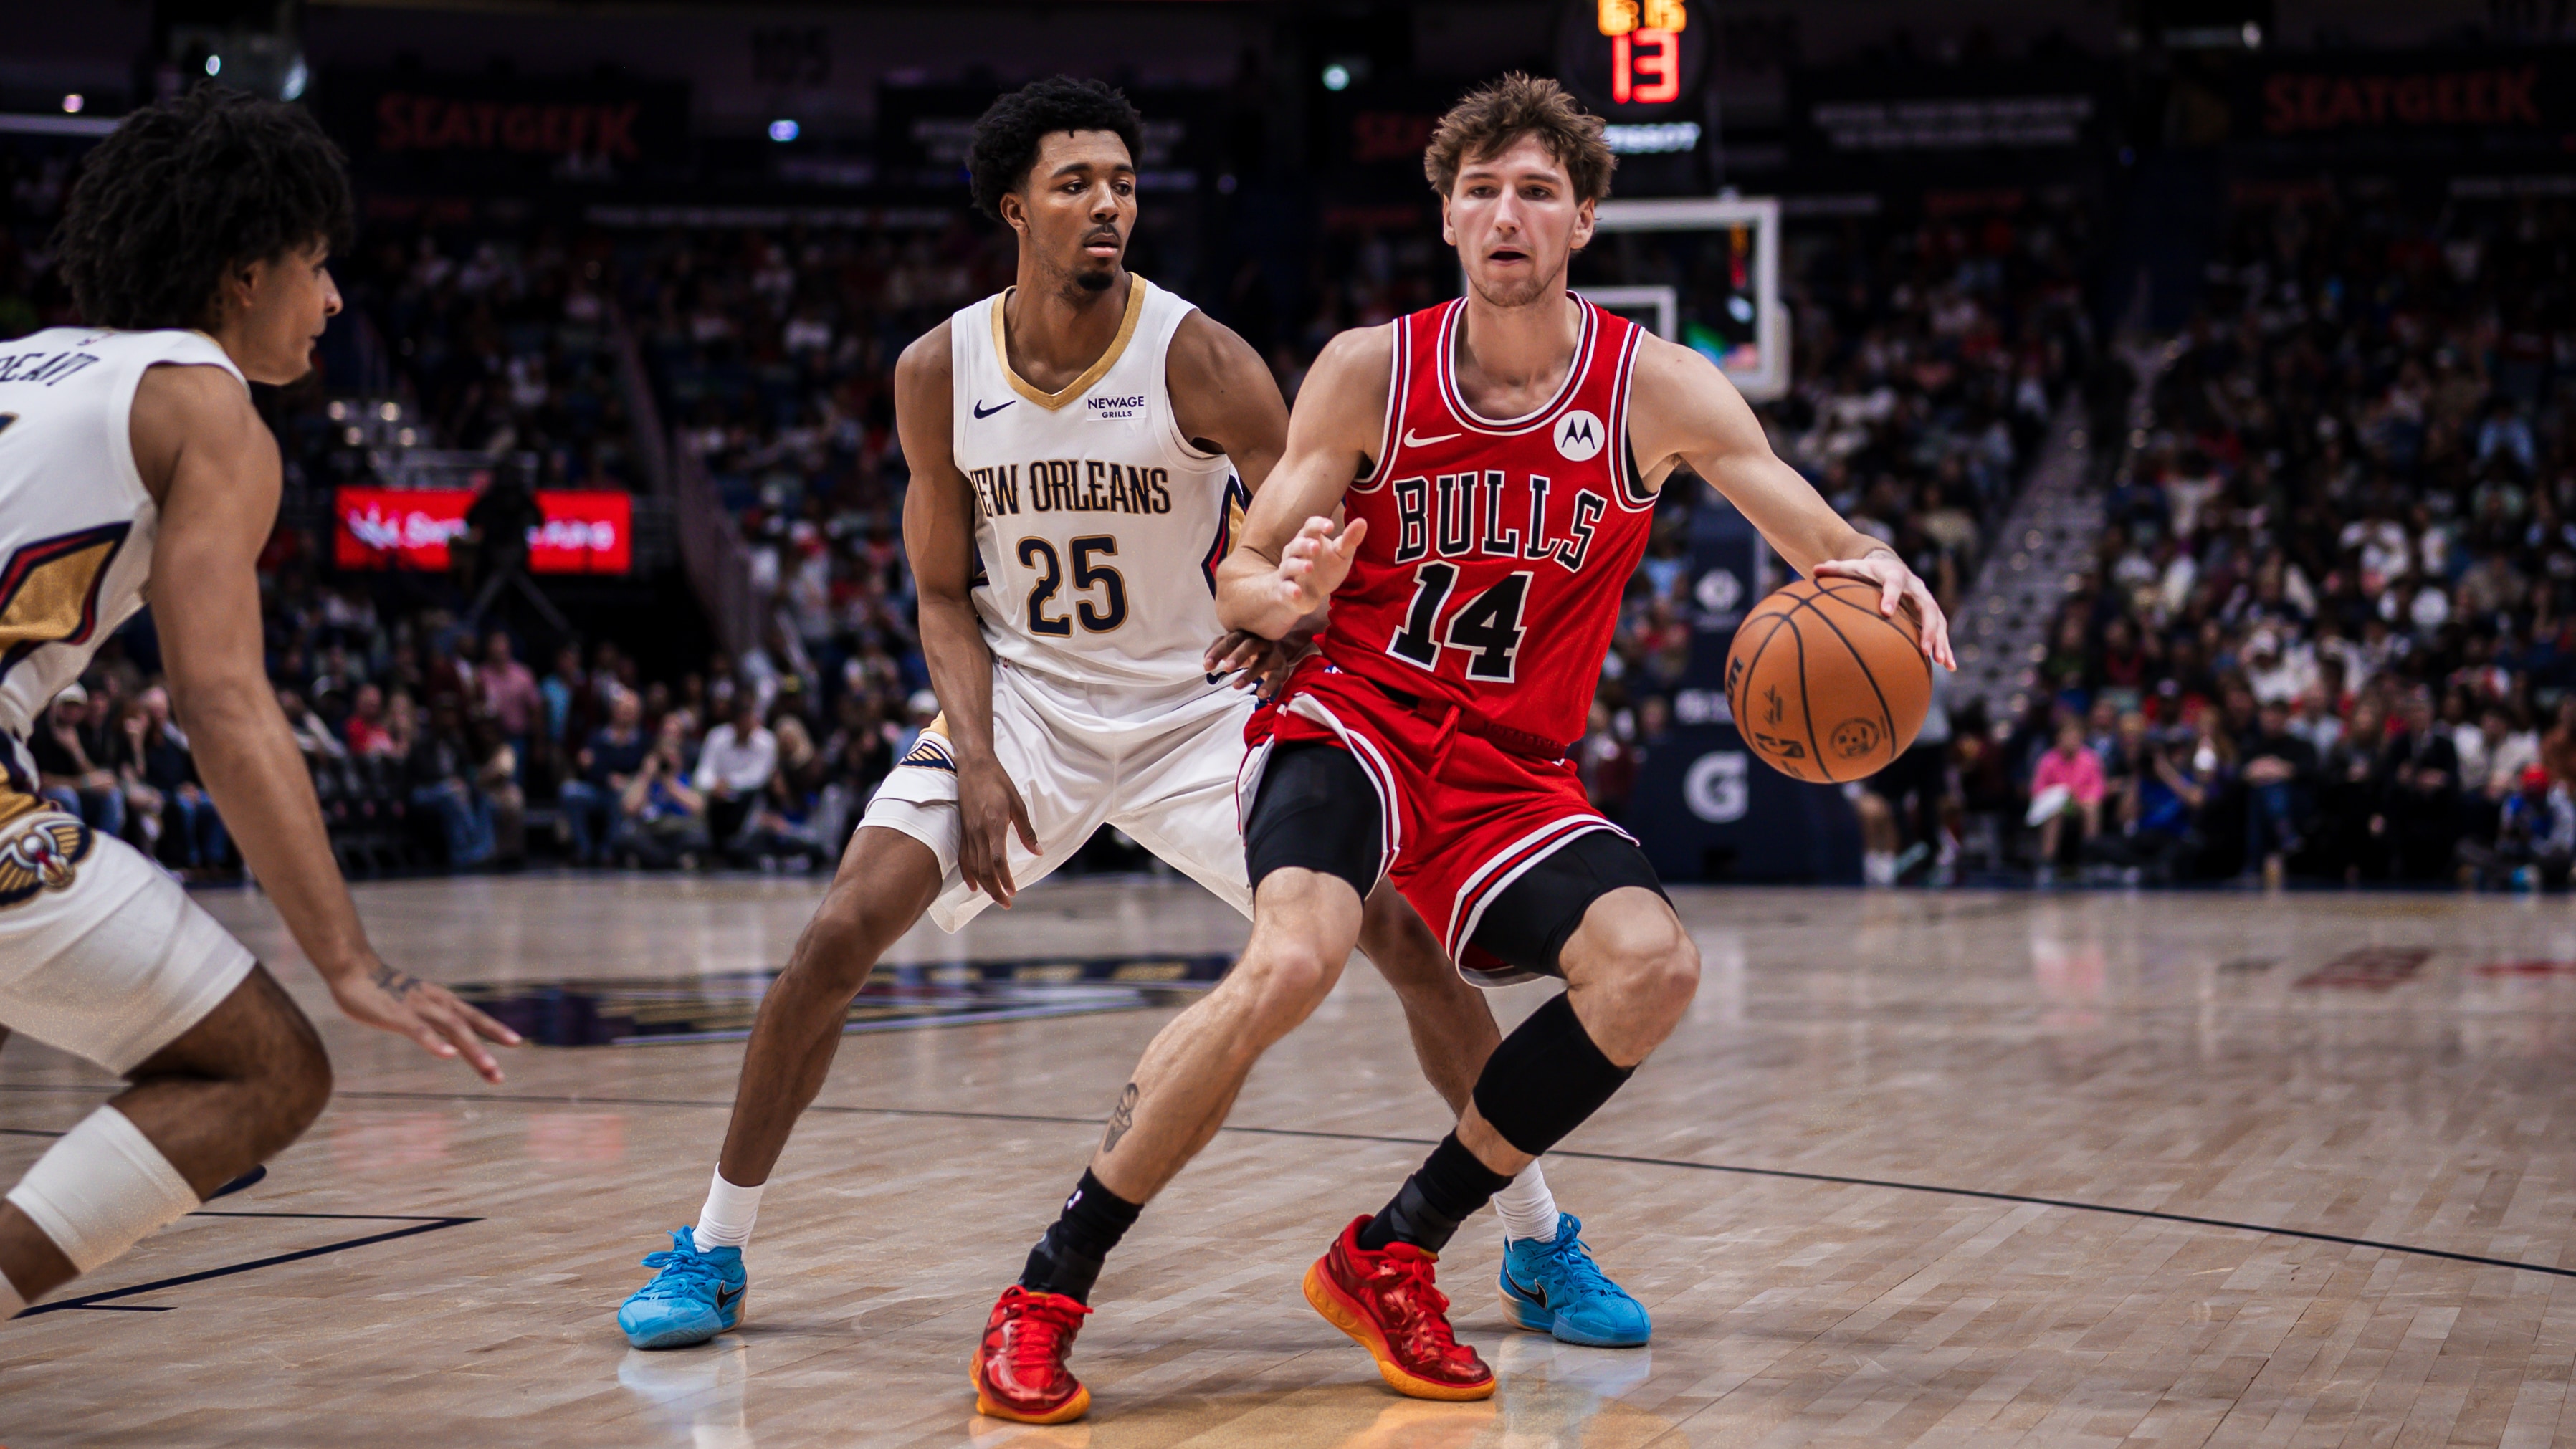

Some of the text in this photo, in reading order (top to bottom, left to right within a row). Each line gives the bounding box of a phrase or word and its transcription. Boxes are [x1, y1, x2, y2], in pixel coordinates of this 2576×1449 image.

[1613, 27, 1679, 104] 13
[1087, 396, 1145, 410] NEWAGE
[1102, 410, 1132, 419] GRILLS
[1029, 459, 1172, 515] ORLEANS
[1393, 469, 1608, 573] BULLS
[1016, 534, 1130, 639] 25
[1385, 559, 1535, 684] 14
